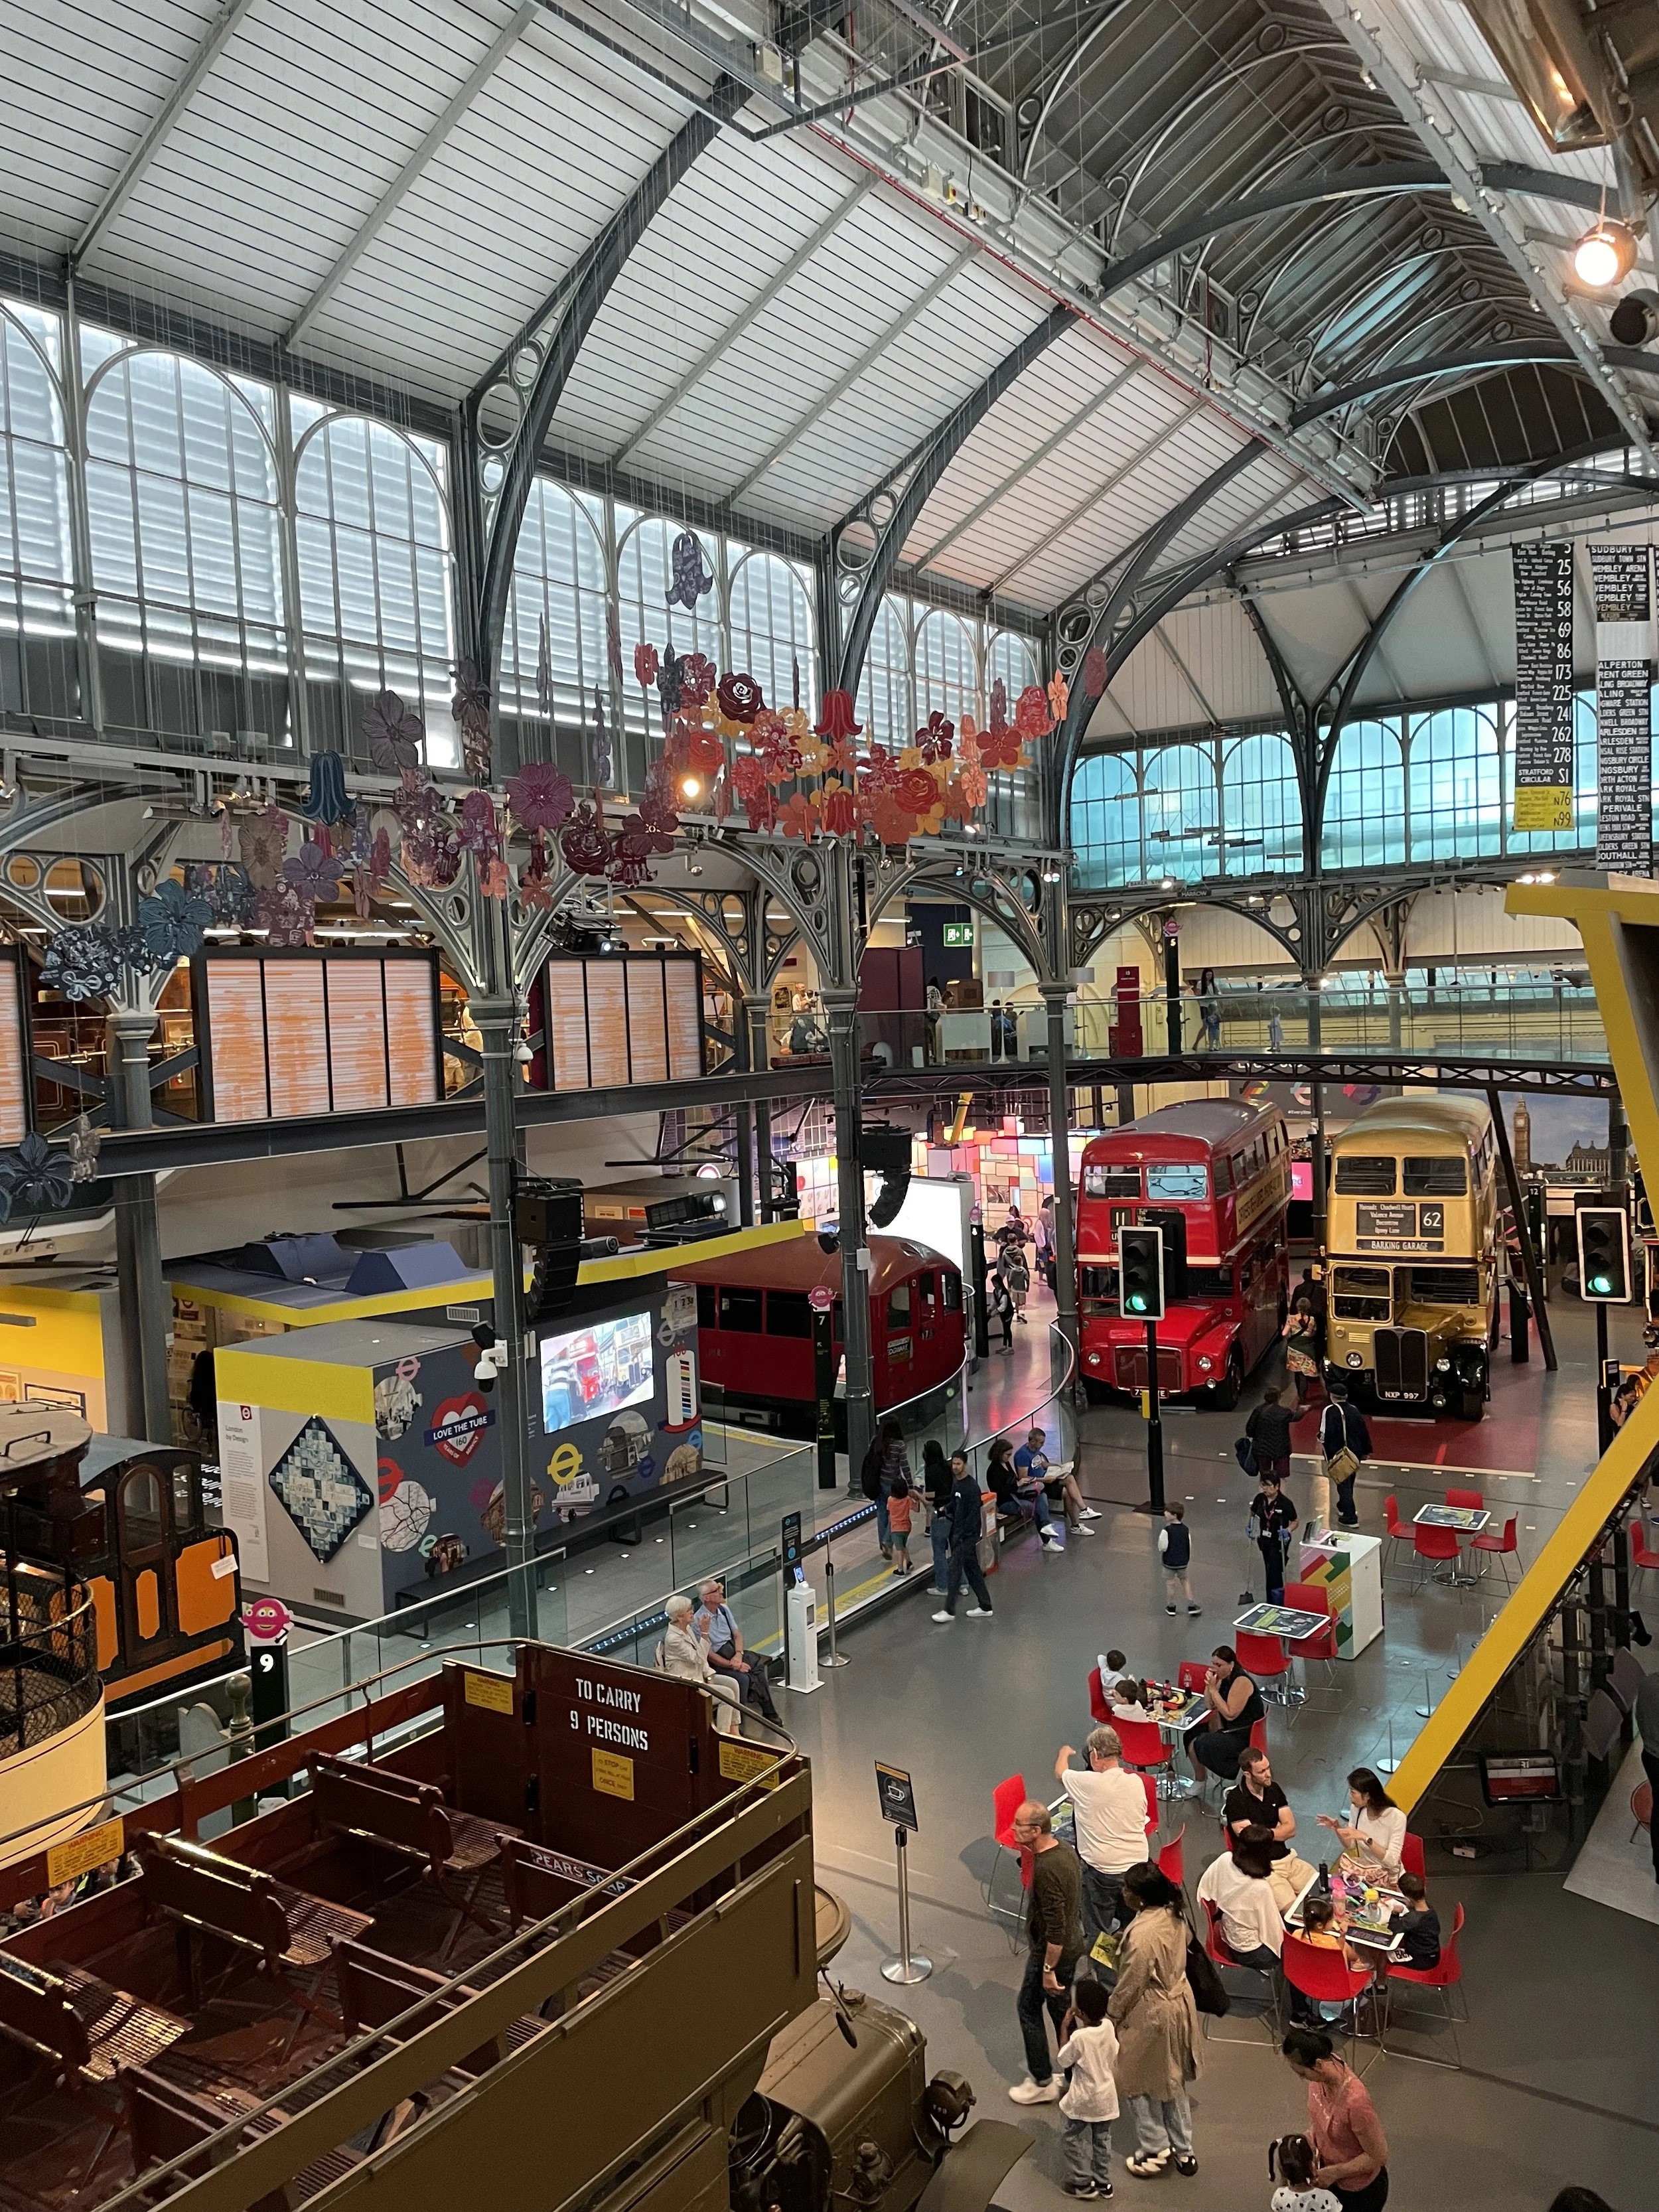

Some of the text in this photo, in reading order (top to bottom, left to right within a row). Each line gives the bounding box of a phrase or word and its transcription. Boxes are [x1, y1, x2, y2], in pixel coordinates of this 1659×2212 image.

[1557, 559, 1571, 575] 25
[1557, 580, 1571, 596] 56
[1557, 601, 1571, 617] 58
[1558, 623, 1571, 638] 69
[1557, 642, 1571, 658] 86
[1555, 664, 1571, 680] 173
[1553, 685, 1571, 701] 225
[1557, 706, 1571, 721] 241
[1551, 726, 1571, 742] 262
[1553, 747, 1571, 763] 278
[1554, 791, 1571, 806] N76
[1553, 812, 1571, 826] N99
[1116, 1212, 1125, 1226] 11
[1423, 1212, 1441, 1226] 62
[1371, 1241, 1428, 1250] BARKING GARAGE
[819, 1315, 826, 1325] 7
[433, 1416, 487, 1440] LOVE THE TUBE
[232, 1435, 249, 1443] Design
[456, 1436, 467, 1447] 160
[443, 1443, 453, 1456] YEARS
[260, 1654, 273, 1672] 9
[575, 1678, 641, 1712] TO CARRY
[571, 1710, 648, 1751] 9 PERSONS
[734, 1747, 763, 1760] WARNING
[68, 1828, 104, 1850] WARNING
